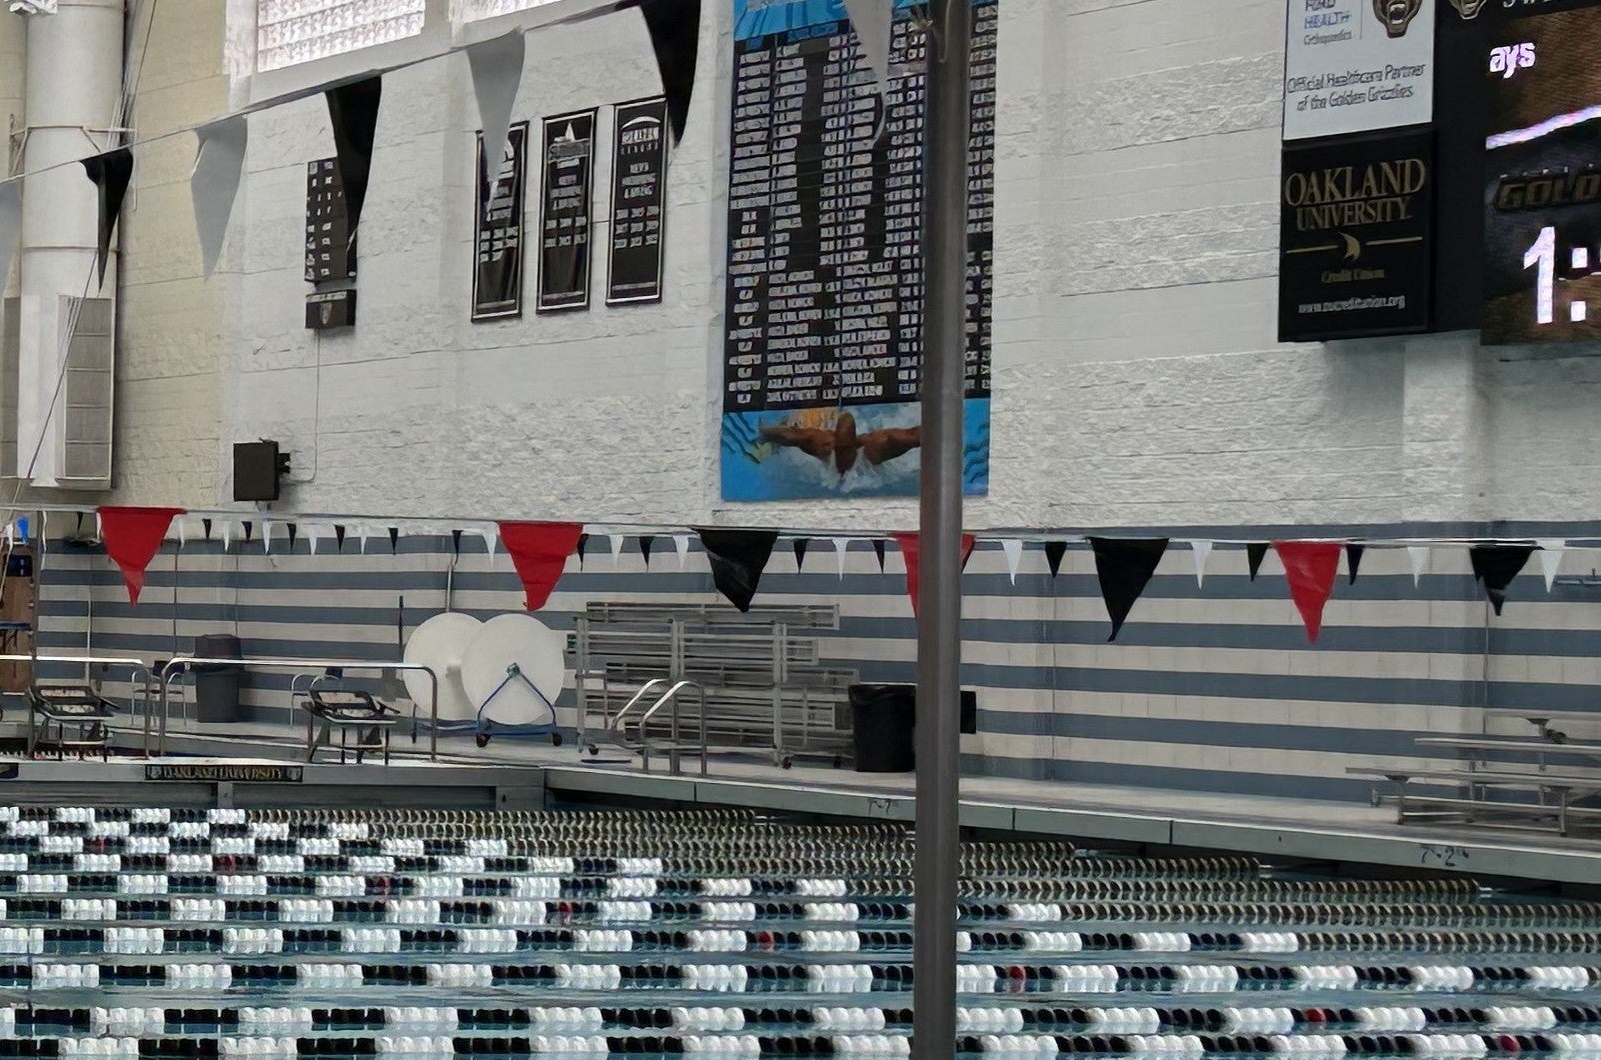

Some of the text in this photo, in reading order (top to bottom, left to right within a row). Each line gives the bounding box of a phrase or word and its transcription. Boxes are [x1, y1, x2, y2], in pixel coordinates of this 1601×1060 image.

[1488, 42, 1536, 79] ays
[1284, 158, 1427, 207] OAKLAND
[1297, 197, 1414, 231] UNIVERSITY
[1523, 225, 1601, 325] 1:
